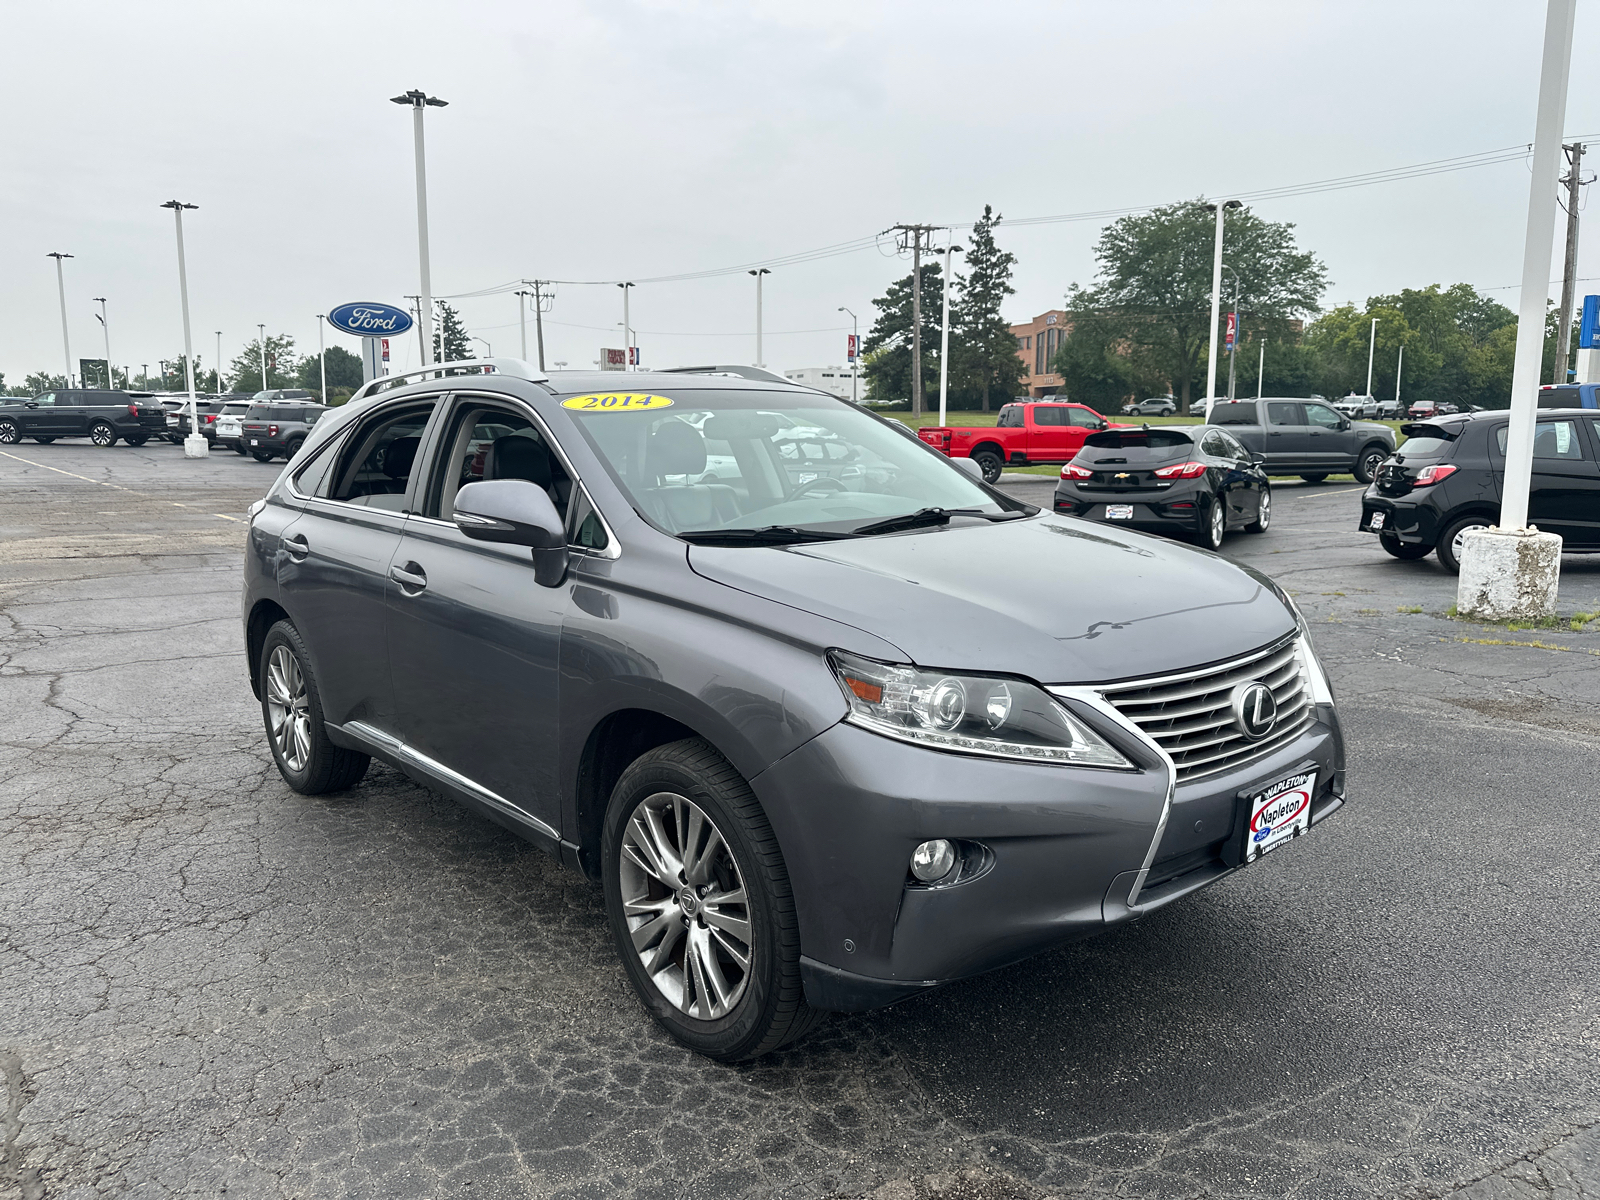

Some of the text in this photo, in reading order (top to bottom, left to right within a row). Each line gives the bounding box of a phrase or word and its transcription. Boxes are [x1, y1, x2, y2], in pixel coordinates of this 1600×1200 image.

[348, 307, 397, 330] Ford
[582, 395, 653, 408] 2014
[1267, 775, 1305, 799] NAPLETON
[1260, 799, 1300, 827] Napleton
[1276, 818, 1302, 834] Libertyville
[1262, 834, 1294, 855] LIBERTYVILLE
